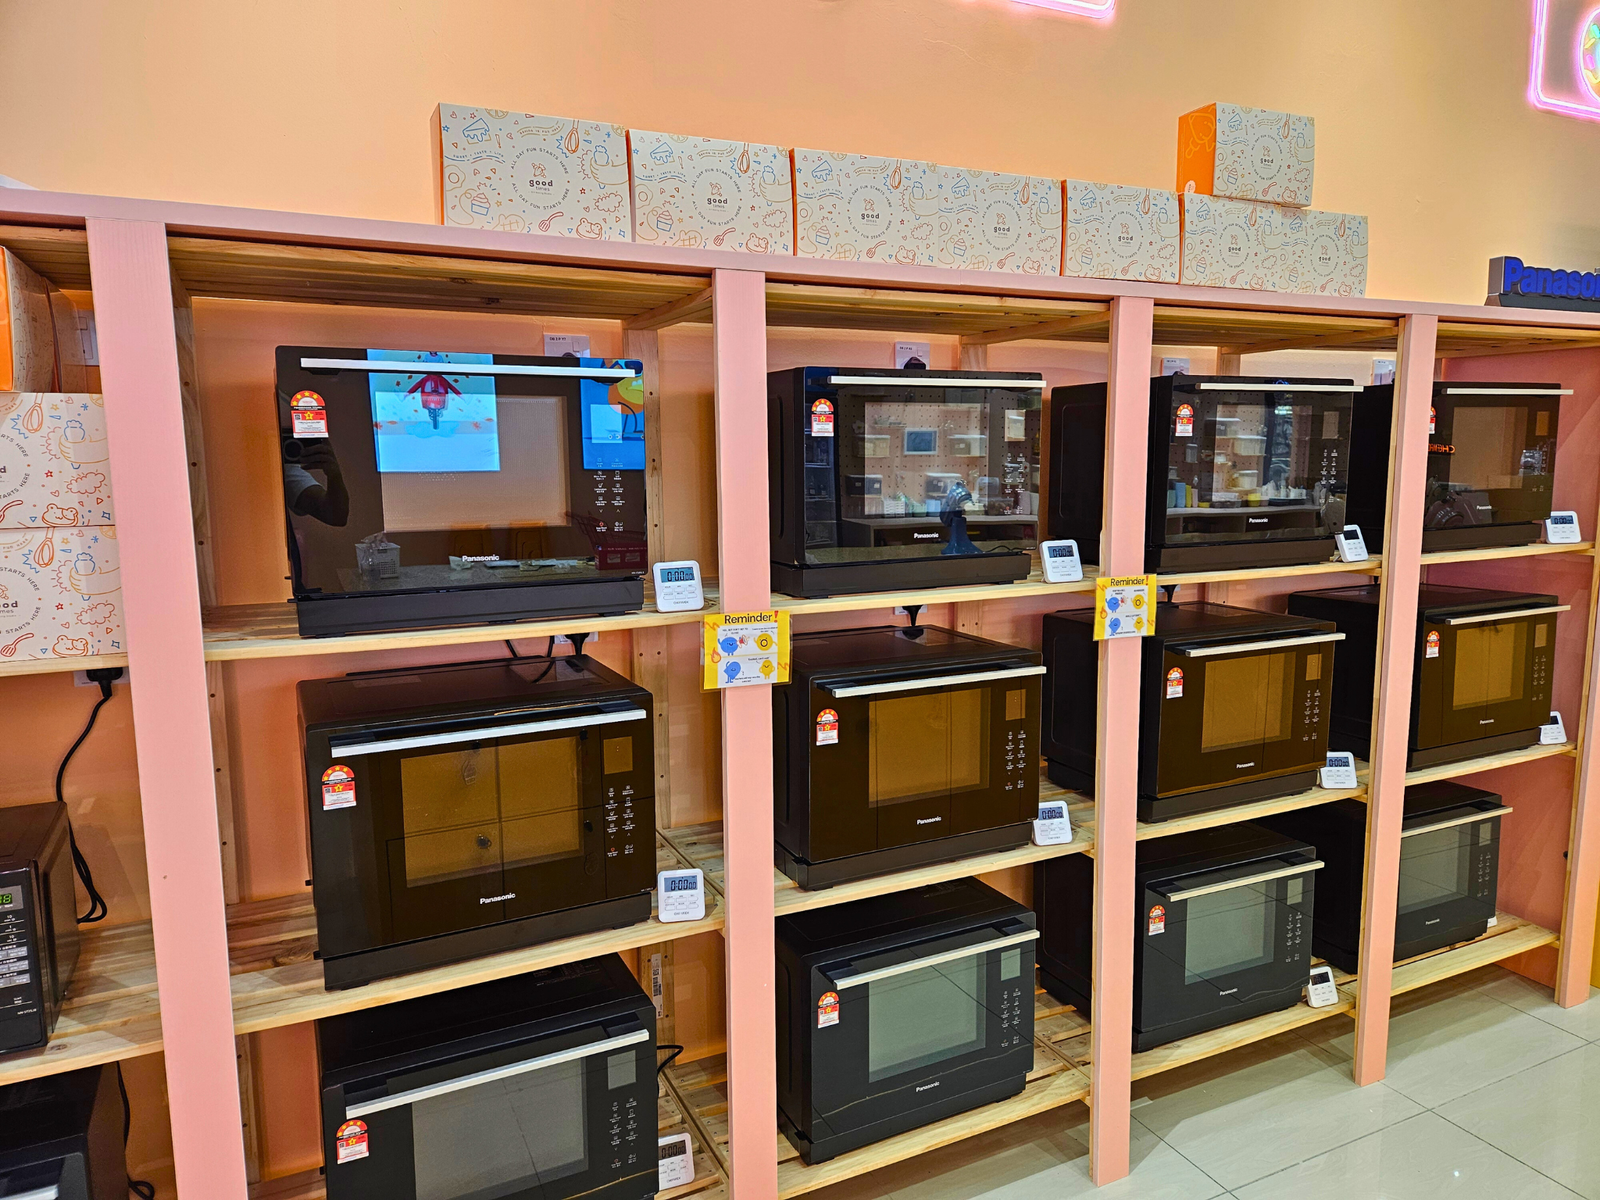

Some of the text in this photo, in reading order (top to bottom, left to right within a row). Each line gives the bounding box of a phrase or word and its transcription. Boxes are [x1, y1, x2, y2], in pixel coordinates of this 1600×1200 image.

[516, 150, 524, 159] DAY
[539, 148, 559, 160] STARTS
[559, 160, 569, 174] HERE
[518, 194, 528, 204] DAY
[543, 201, 562, 210] STARTS
[561, 188, 570, 201] HERE
[0, 434, 29, 458] RTS HERE
[19, 473, 30, 487] HERE
[462, 554, 500, 562] Panasonic
[27, 577, 40, 592] HERE
[5, 606, 41, 635] STARTS HERE
[917, 816, 942, 825] Panasonic
[480, 893, 516, 904] Panasonic
[916, 1081, 940, 1092] Panasonic
